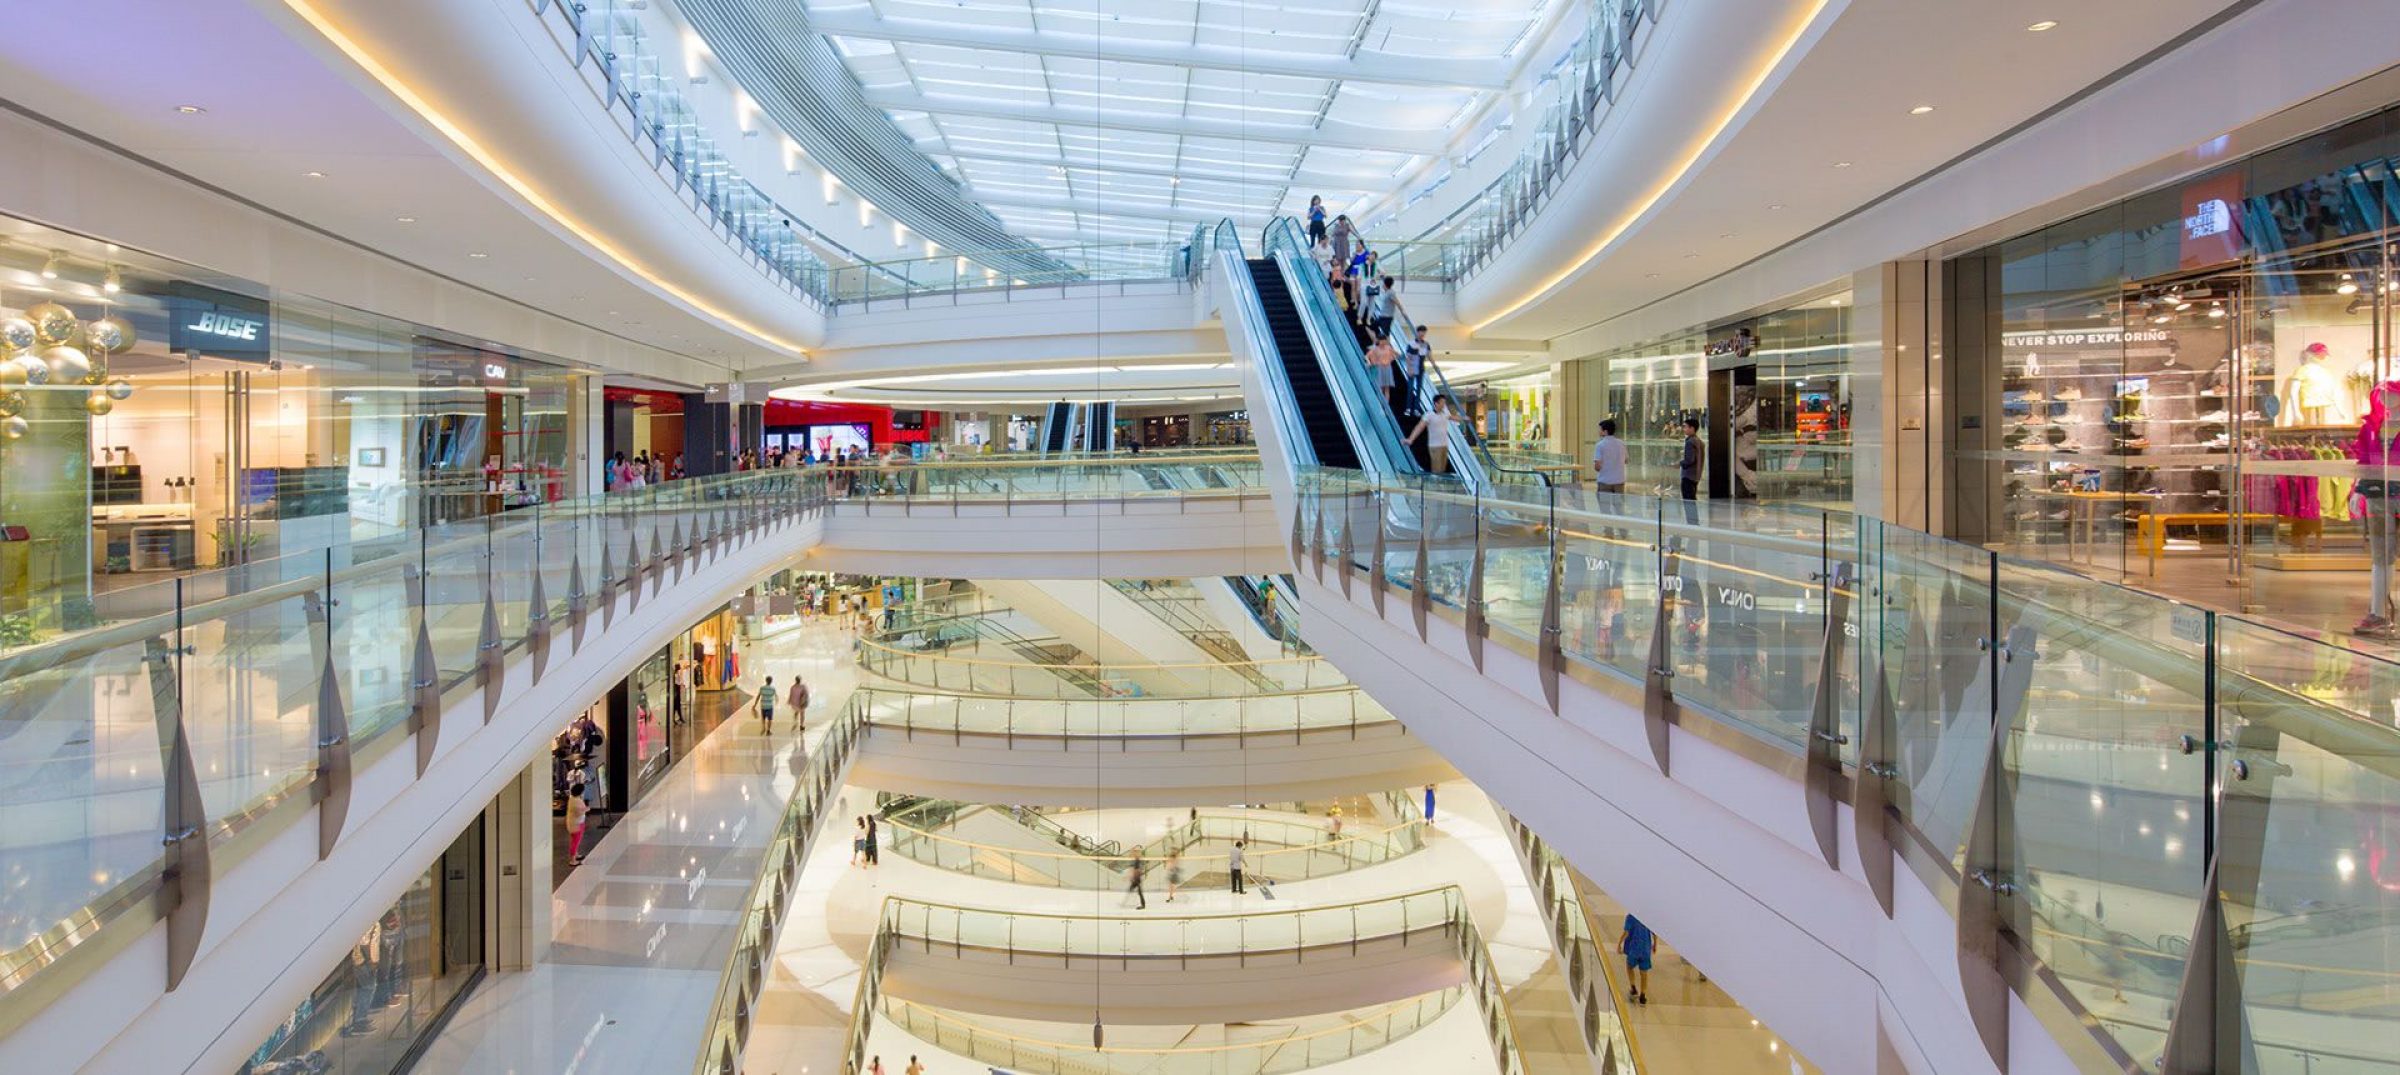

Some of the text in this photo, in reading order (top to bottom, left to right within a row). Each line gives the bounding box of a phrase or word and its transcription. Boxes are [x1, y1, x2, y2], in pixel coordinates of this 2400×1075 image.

[2197, 201, 2215, 215] THE
[2184, 213, 2215, 229] NORTH
[2191, 223, 2215, 239] FACE
[187, 311, 264, 341] BOSE
[2001, 330, 2167, 347] NEVER STOP EXPLORING
